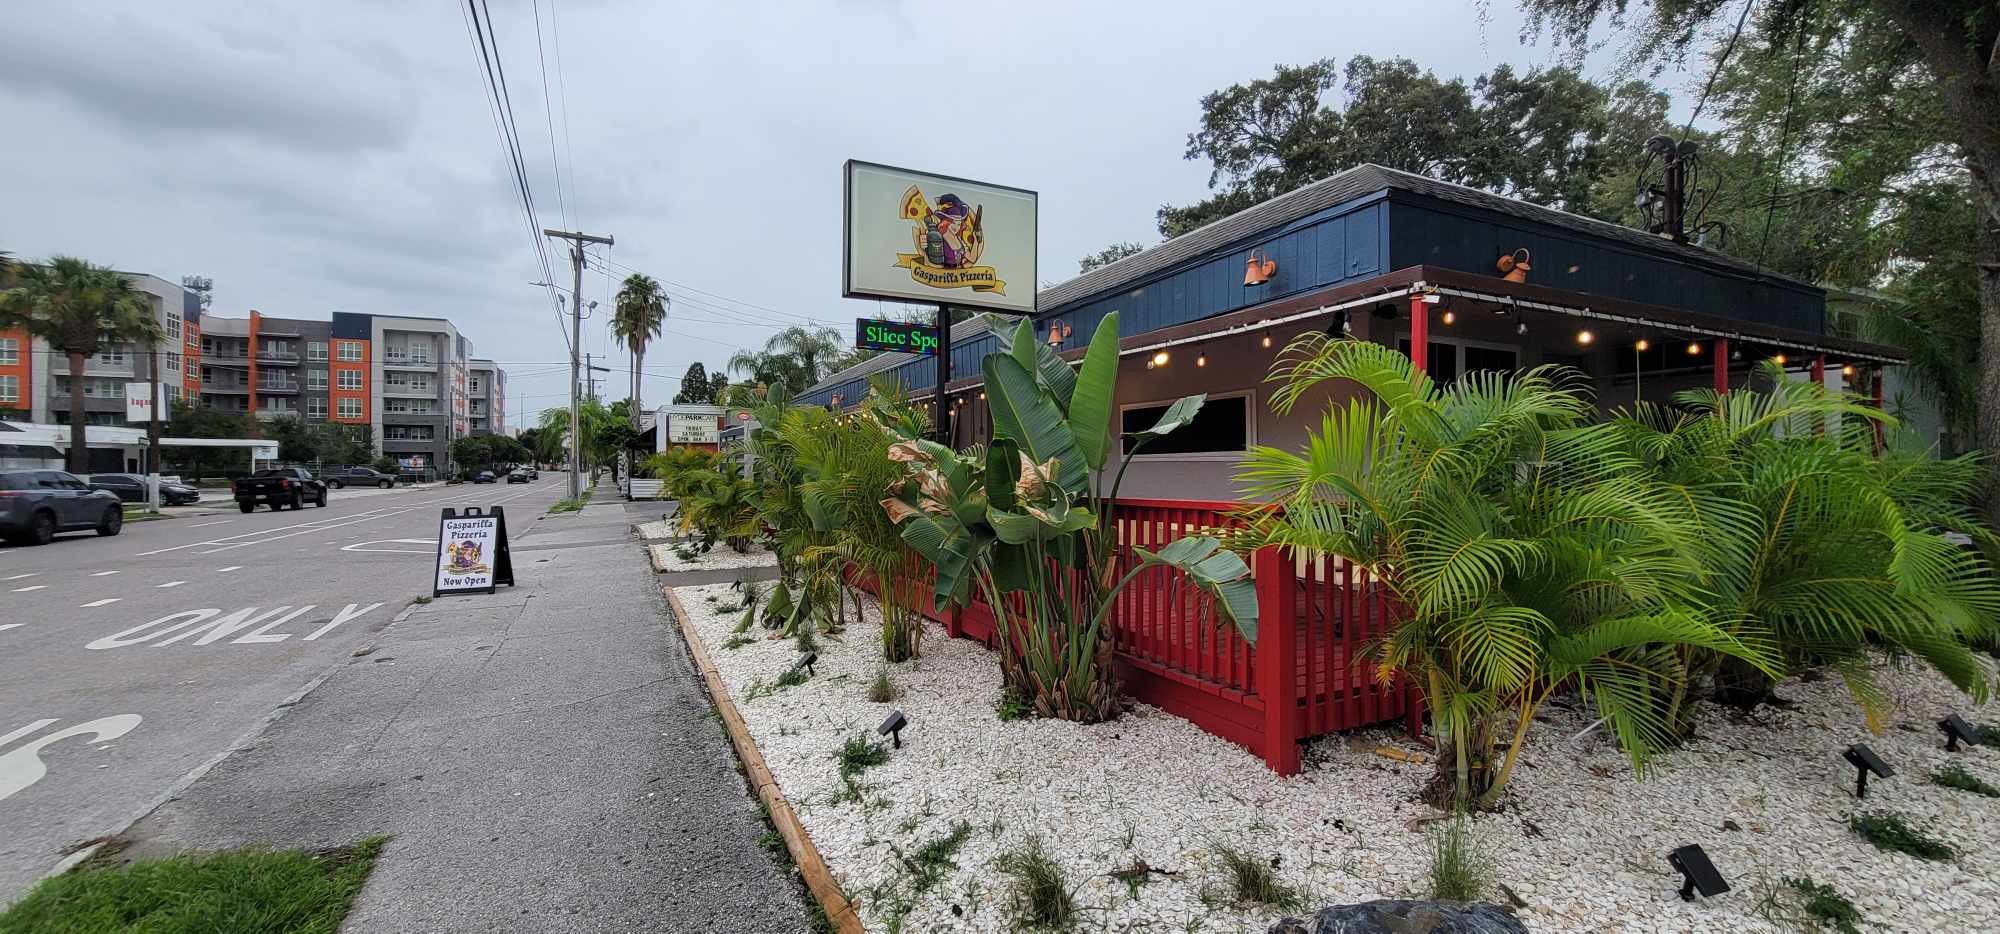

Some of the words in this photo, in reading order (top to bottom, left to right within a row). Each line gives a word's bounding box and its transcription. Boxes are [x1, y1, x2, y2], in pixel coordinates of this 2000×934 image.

[960, 270, 993, 282] Pizzeria
[451, 530, 487, 539] Pizzeria
[443, 577, 462, 586] Now
[464, 576, 486, 586] Open
[85, 602, 385, 650] ONLY
